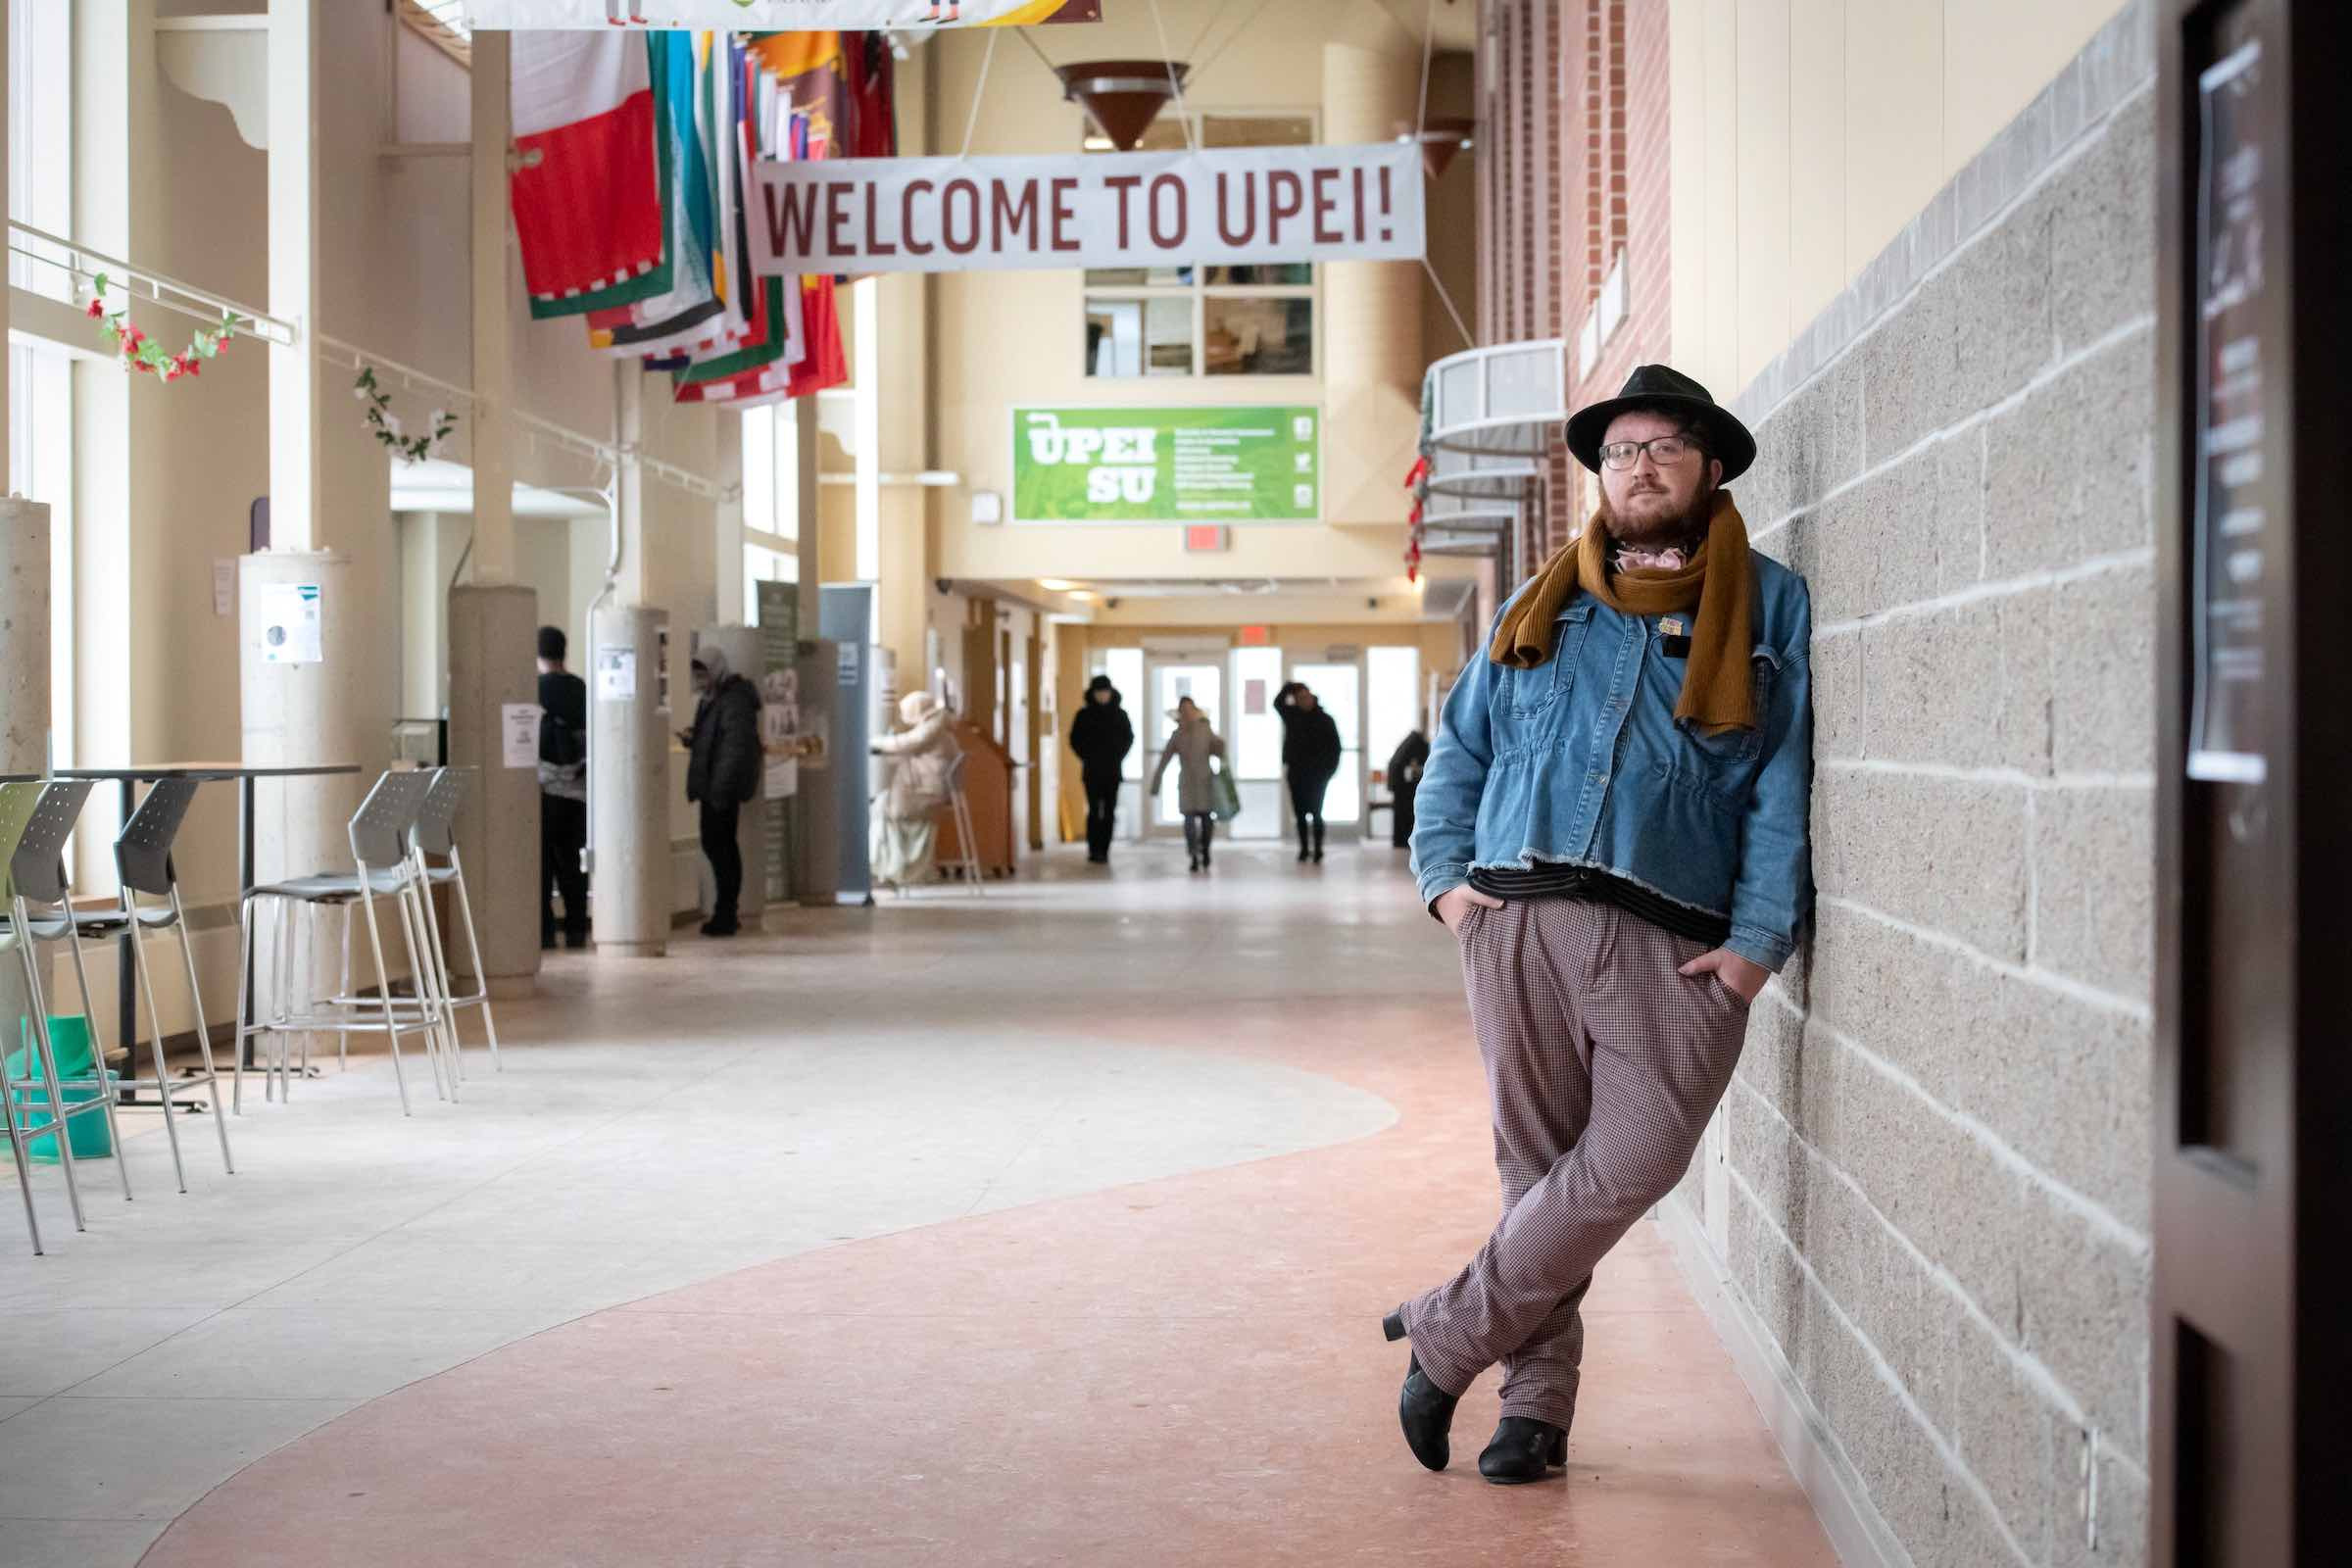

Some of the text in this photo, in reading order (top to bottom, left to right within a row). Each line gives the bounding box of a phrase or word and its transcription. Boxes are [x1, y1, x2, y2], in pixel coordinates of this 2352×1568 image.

[762, 166, 1393, 258] WELCOME TO UPEI!
[1026, 419, 1157, 465] UPEI
[1087, 466, 1157, 503] SU
